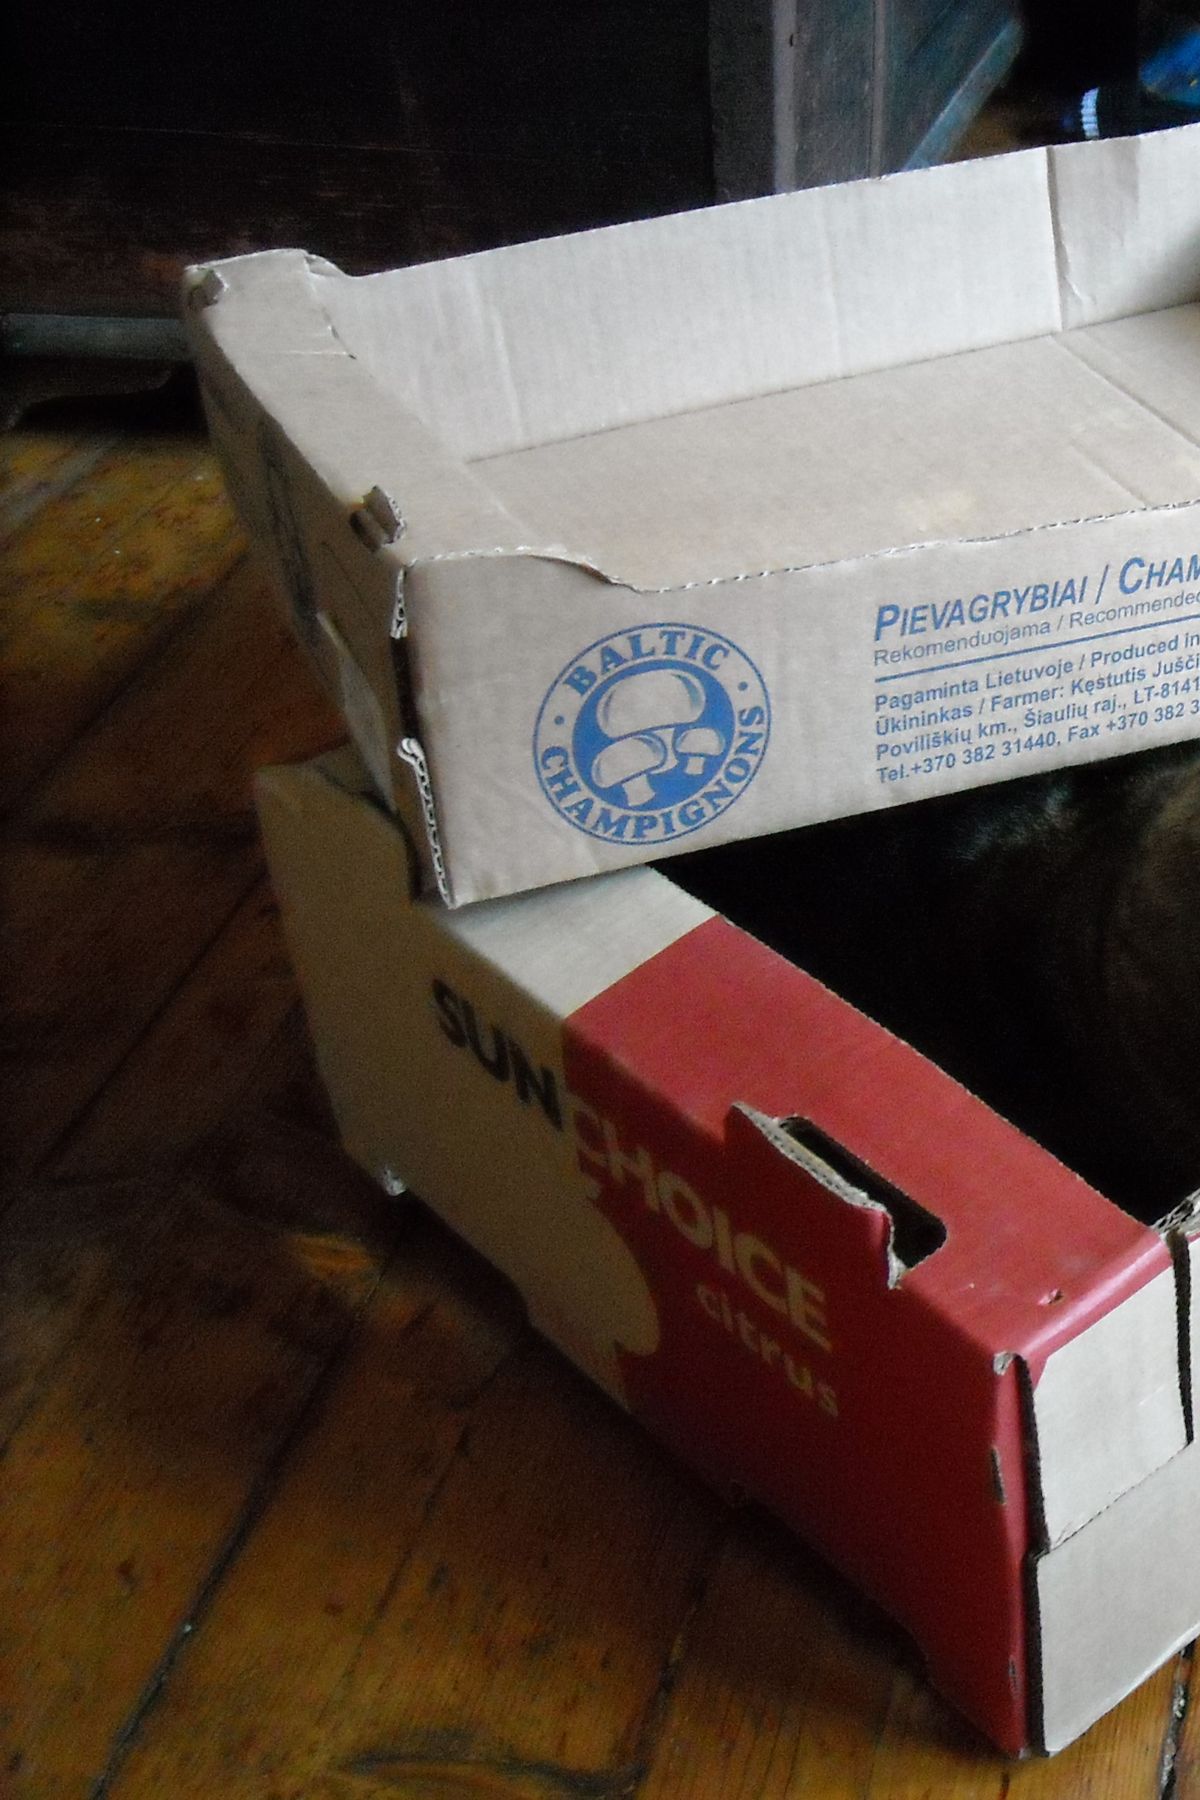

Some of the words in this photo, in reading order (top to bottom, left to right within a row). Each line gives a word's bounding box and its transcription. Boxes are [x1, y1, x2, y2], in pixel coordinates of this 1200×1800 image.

[874, 576, 1088, 641] PIEVAGRYBIAI
[1095, 564, 1109, 604] /
[563, 630, 729, 696] BALTIC
[874, 621, 1051, 666] Rekomenduojama
[1057, 615, 1064, 631] /
[875, 680, 979, 713] Pagaminta
[986, 658, 1073, 690] Lietuvoje
[1091, 635, 1179, 667] Produced
[1185, 632, 1200, 648] in
[876, 704, 973, 736] Ūkininkas
[991, 685, 1064, 712] Farmer:
[1071, 667, 1146, 695] Kęstutis
[876, 728, 972, 760] Poviliškių
[978, 722, 1017, 739] km.,
[1024, 702, 1088, 730] Šiaulių
[1094, 694, 1126, 715] raj.,
[962, 744, 995, 765] 382
[1002, 731, 1061, 756] 31440,
[1067, 724, 1100, 742] Fax
[1106, 710, 1148, 732] +370
[1154, 702, 1185, 723] 382
[541, 704, 764, 839] CHAMPIGNONS
[697, 1283, 840, 1419] citrus
